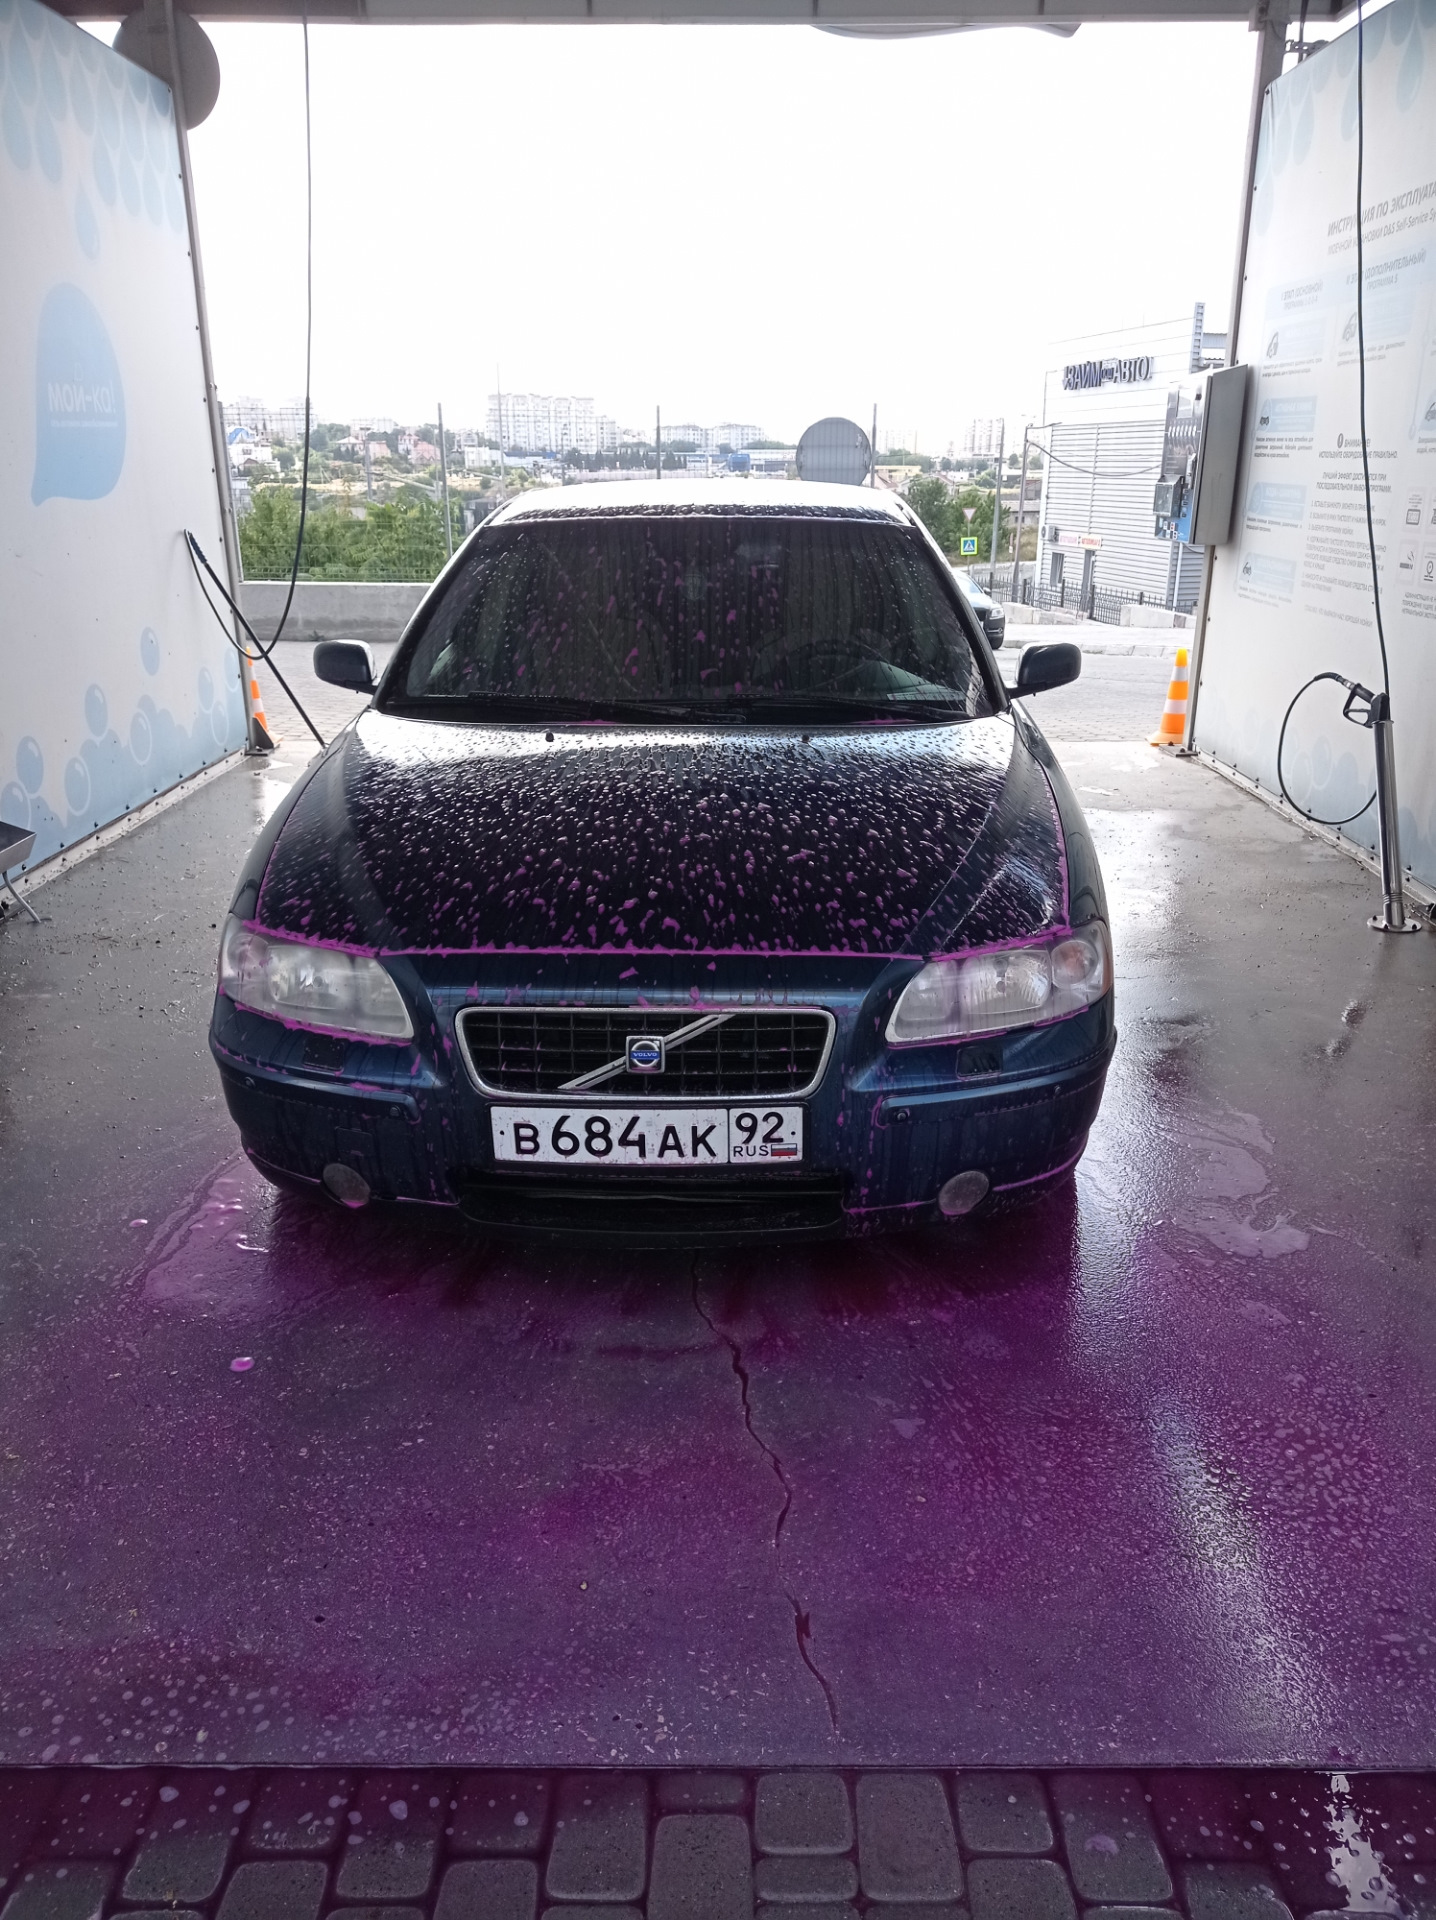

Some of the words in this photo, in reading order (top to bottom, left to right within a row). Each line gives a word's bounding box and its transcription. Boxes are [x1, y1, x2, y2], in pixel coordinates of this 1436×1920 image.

[1376, 200, 1389, 219] ПО
[1352, 229, 1383, 248] УАНОВКИ
[1396, 212, 1429, 233] Self-Service
[1344, 438, 1371, 448] ВНИМАНЕ!
[735, 1111, 785, 1145] 92
[733, 1145, 770, 1158] RUS
